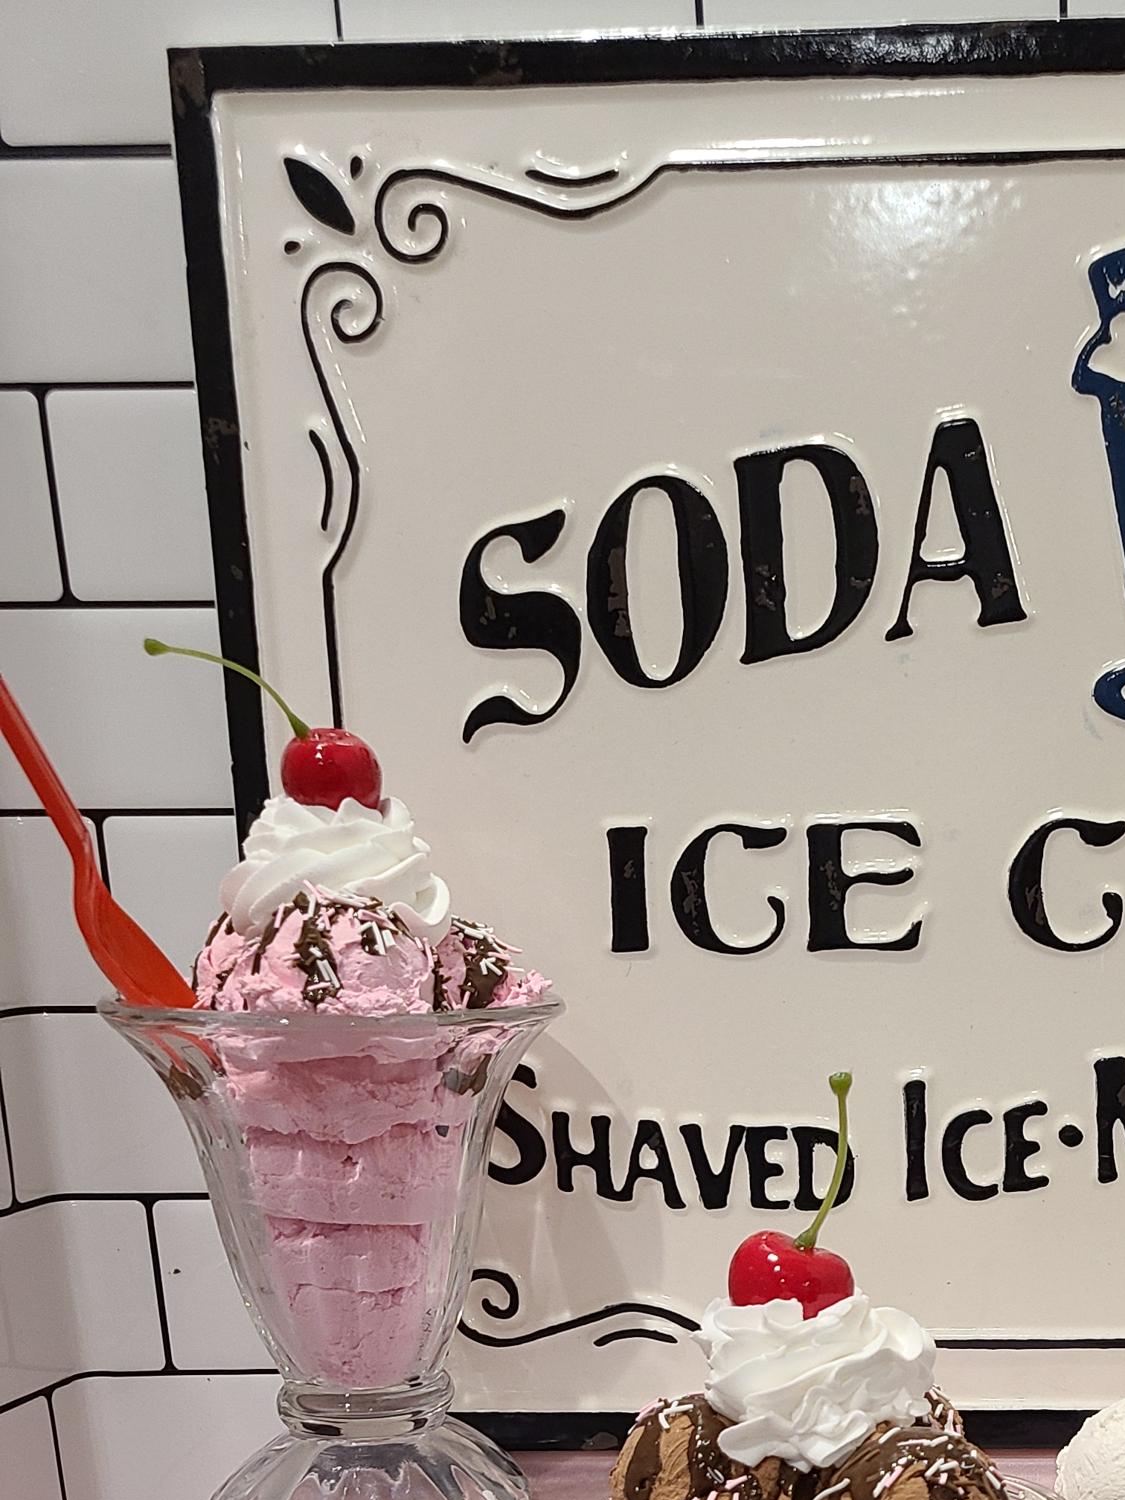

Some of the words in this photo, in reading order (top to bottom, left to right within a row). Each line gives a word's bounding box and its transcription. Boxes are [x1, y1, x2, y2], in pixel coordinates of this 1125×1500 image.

[458, 416, 1029, 744] SODA
[605, 820, 924, 957] ICE
[486, 1062, 857, 1212] SHAVED
